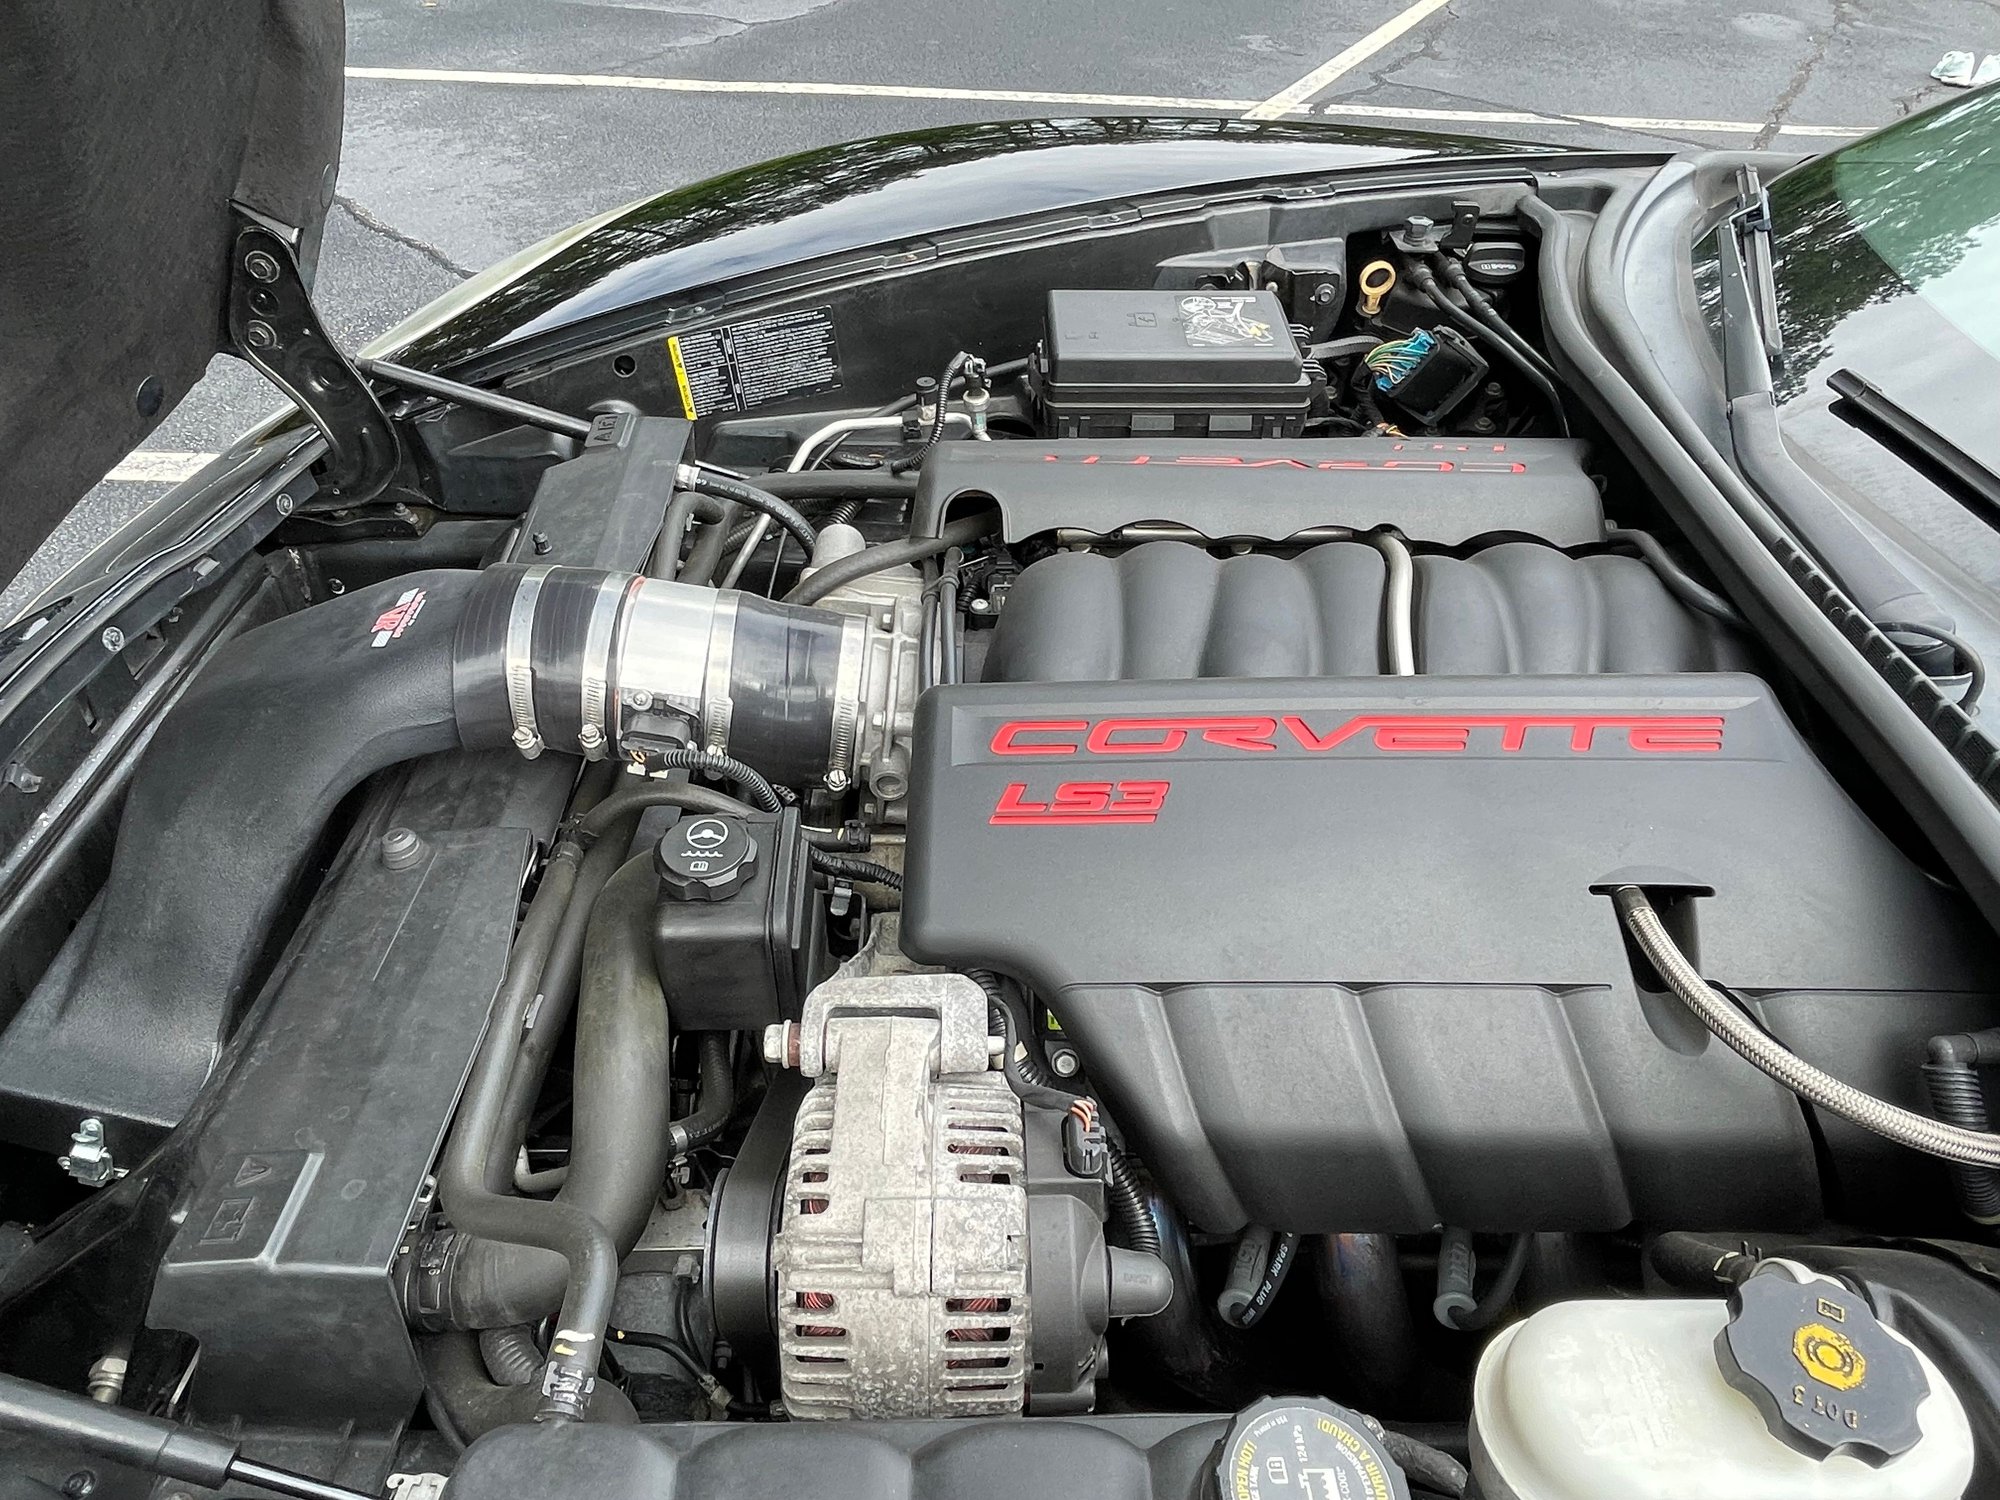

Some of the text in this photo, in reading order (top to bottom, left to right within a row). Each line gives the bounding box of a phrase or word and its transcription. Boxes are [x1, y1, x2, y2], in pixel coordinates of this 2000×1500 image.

[989, 714, 1725, 756] CORVETTE
[998, 780, 1171, 812] LS3
[1255, 1243, 1289, 1306] SPARK PLUG
[1791, 1384, 1859, 1430] DOT 3
[1296, 1446, 1308, 1463] 124
[1316, 1417, 1361, 1453] CHAUD!
[1235, 1439, 1258, 1500] OPEN HOT!
[1249, 1465, 1260, 1488] TANK
